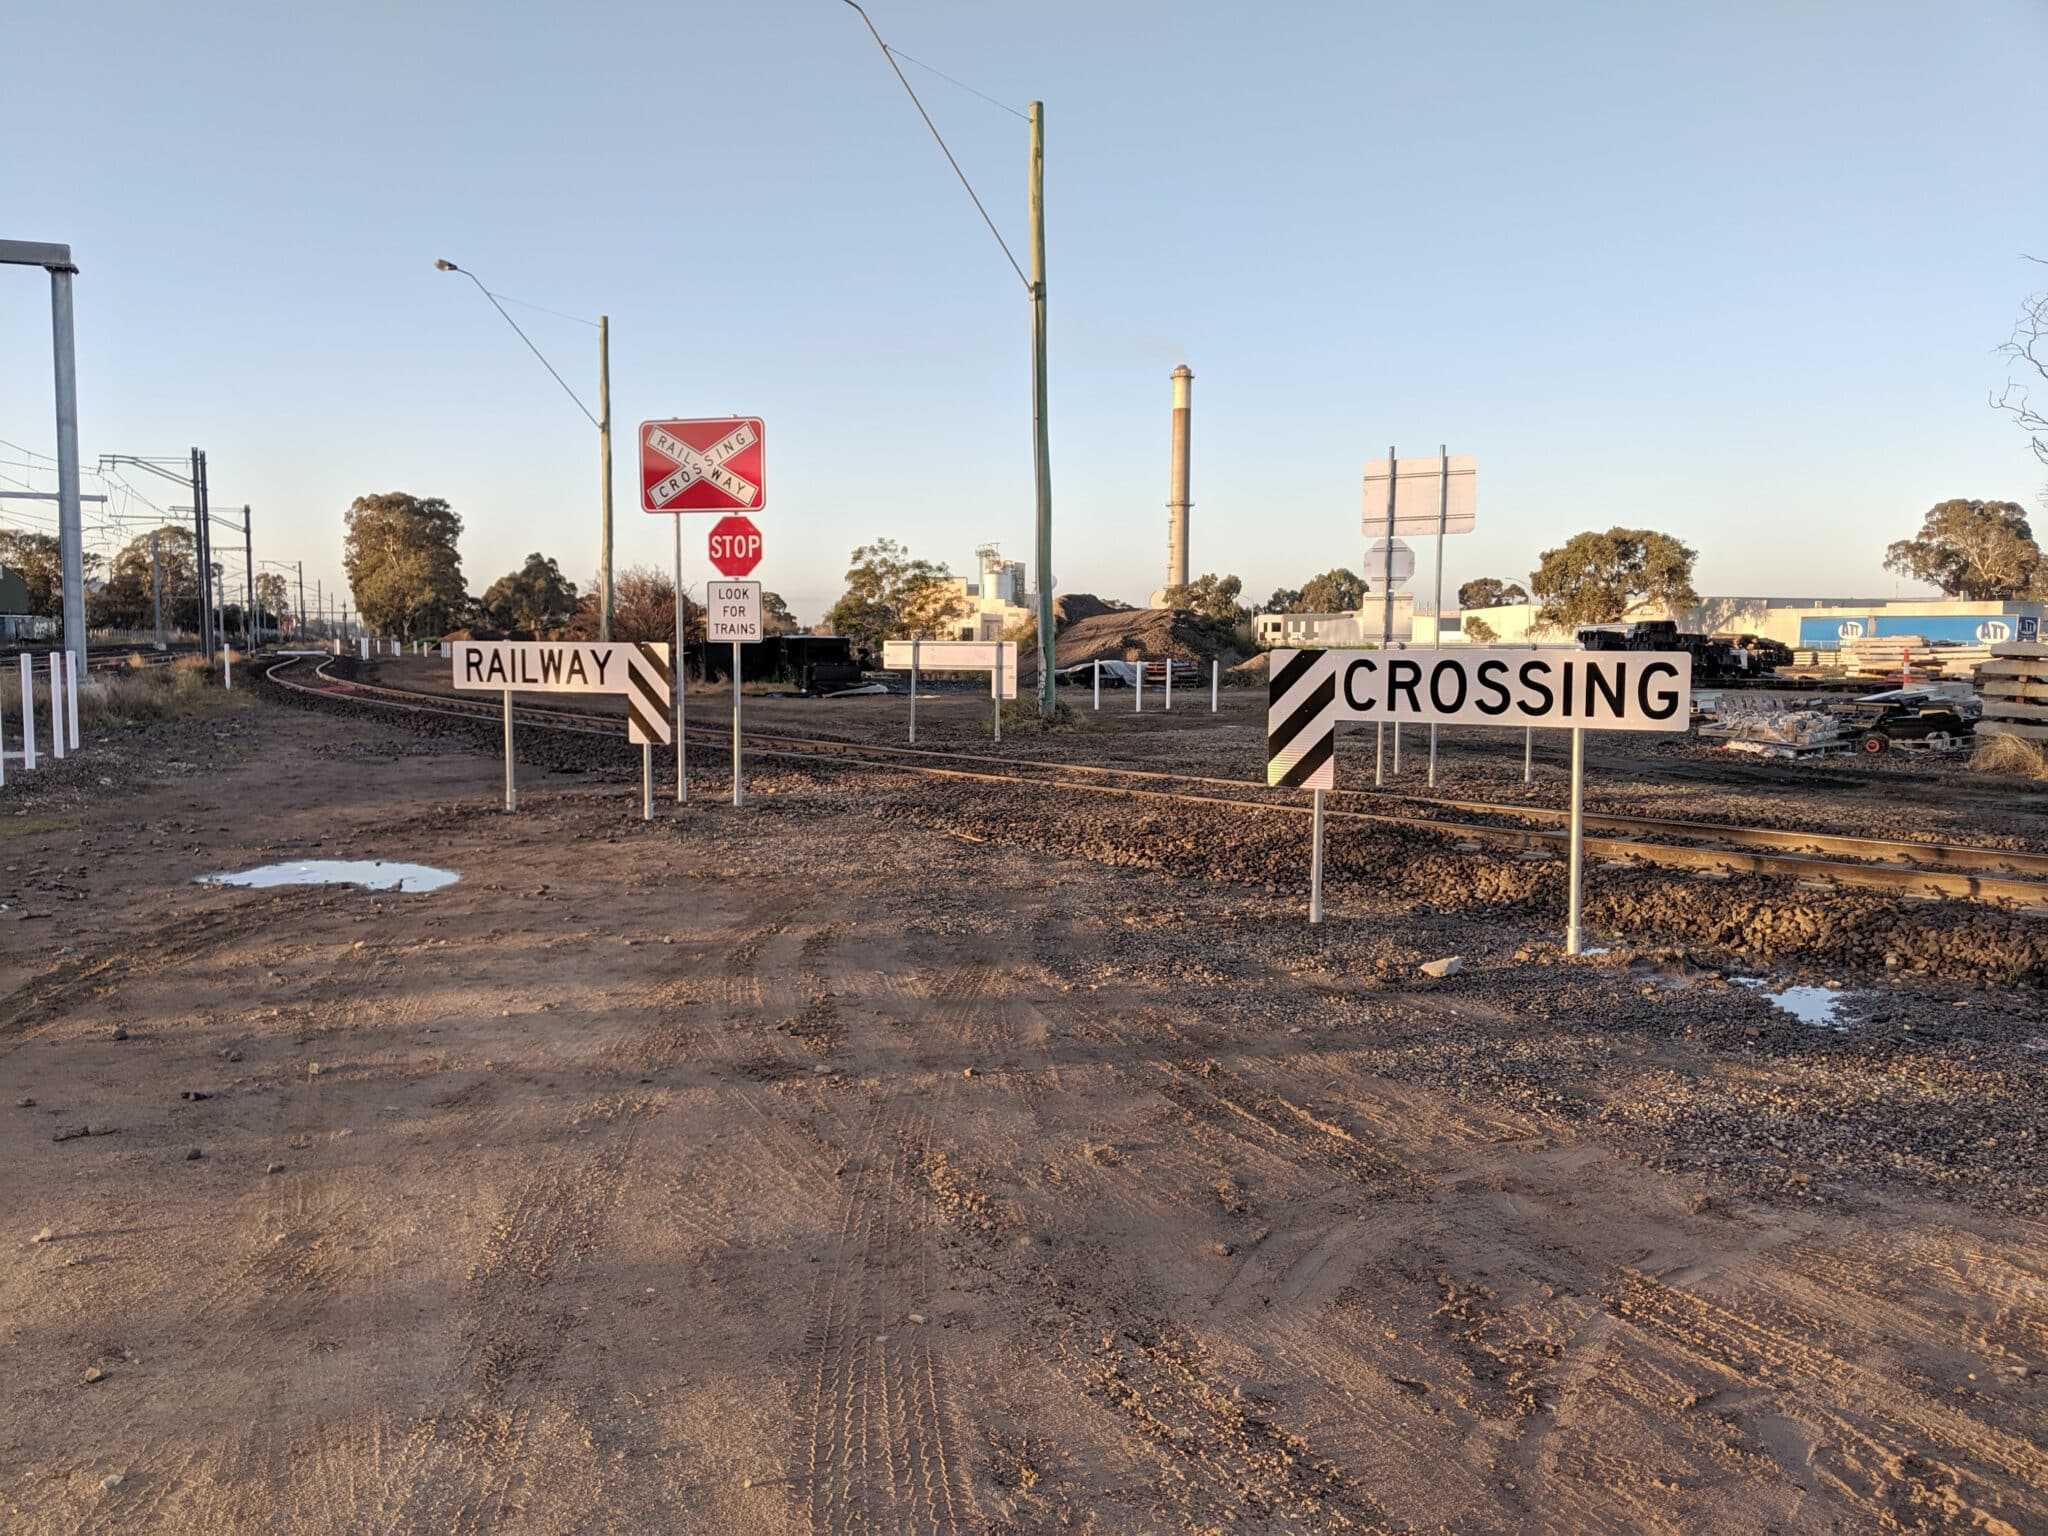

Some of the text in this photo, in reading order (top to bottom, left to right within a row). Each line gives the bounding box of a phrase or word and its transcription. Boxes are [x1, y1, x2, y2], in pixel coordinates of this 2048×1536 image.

[658, 432, 746, 499] CROSSING
[711, 535, 760, 559] STOP
[718, 588, 750, 600] LOOK
[723, 605, 746, 617] FOR
[714, 623, 756, 635] TRAINS
[466, 648, 613, 685] RAILWAY
[1343, 658, 1679, 721] CROSSING
